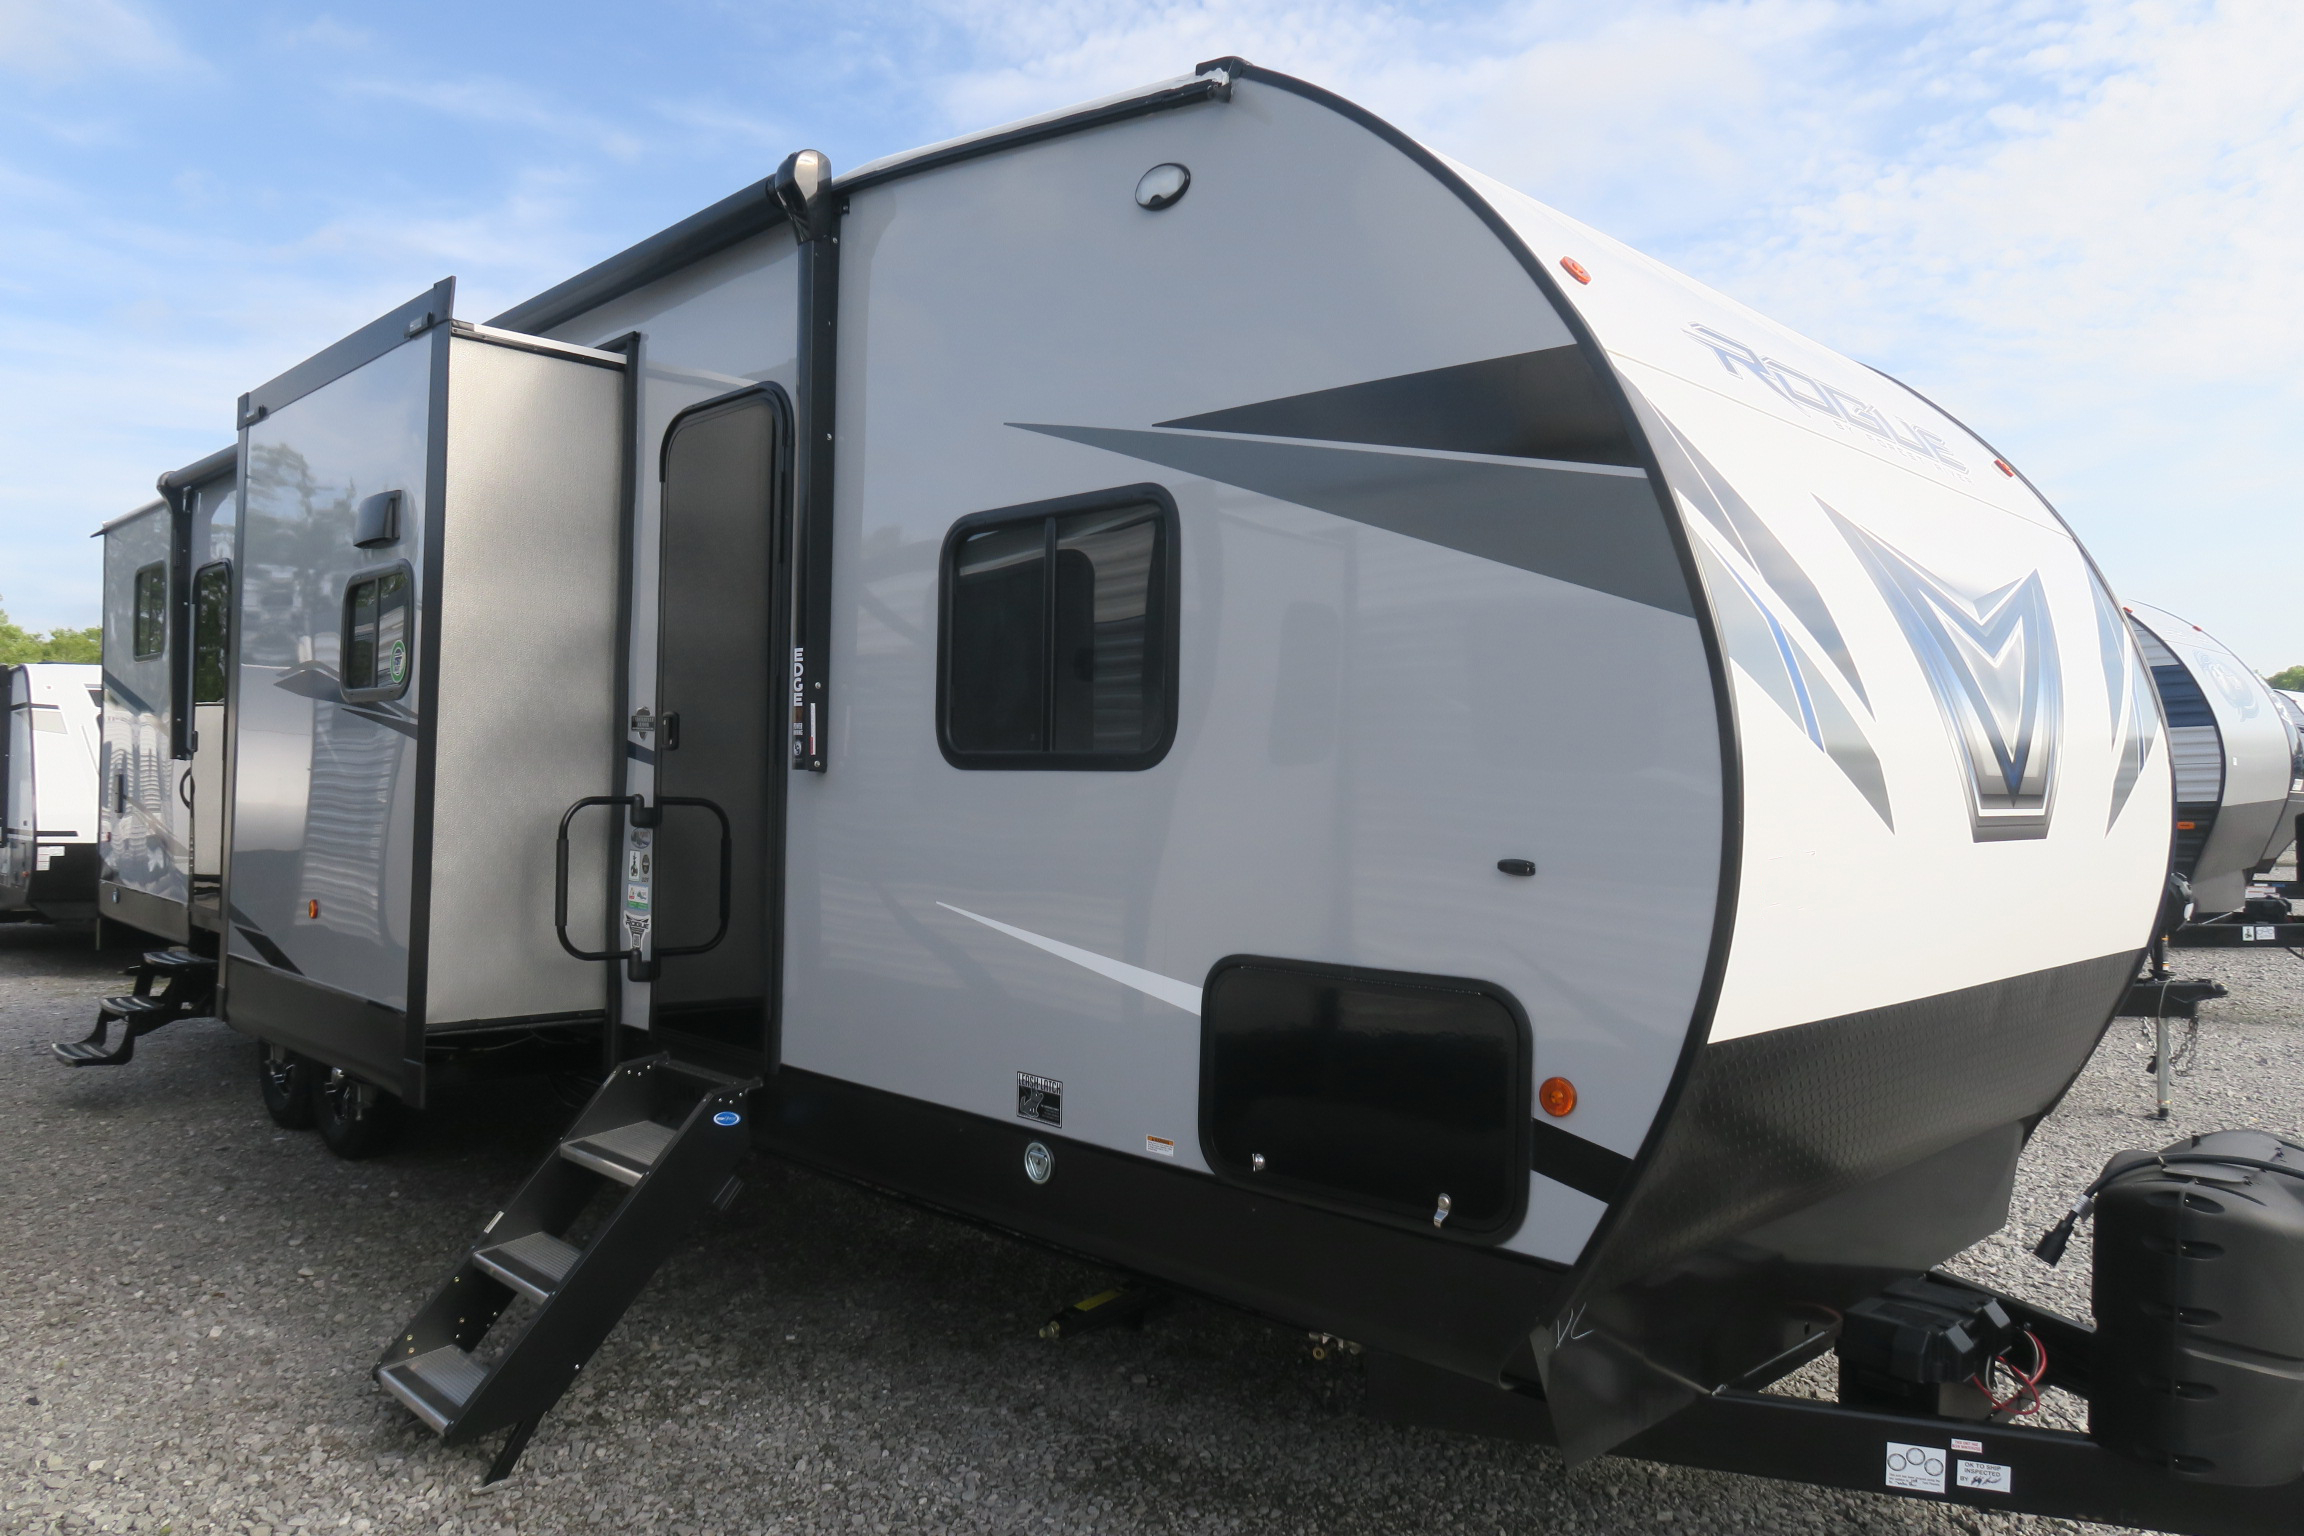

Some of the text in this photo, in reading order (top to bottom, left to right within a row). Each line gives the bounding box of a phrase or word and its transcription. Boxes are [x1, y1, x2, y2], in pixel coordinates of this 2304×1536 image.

[1681, 321, 1970, 475] ROGUE
[793, 648, 803, 706] EDGE
[1964, 1468, 2001, 1477] INSPECTED
